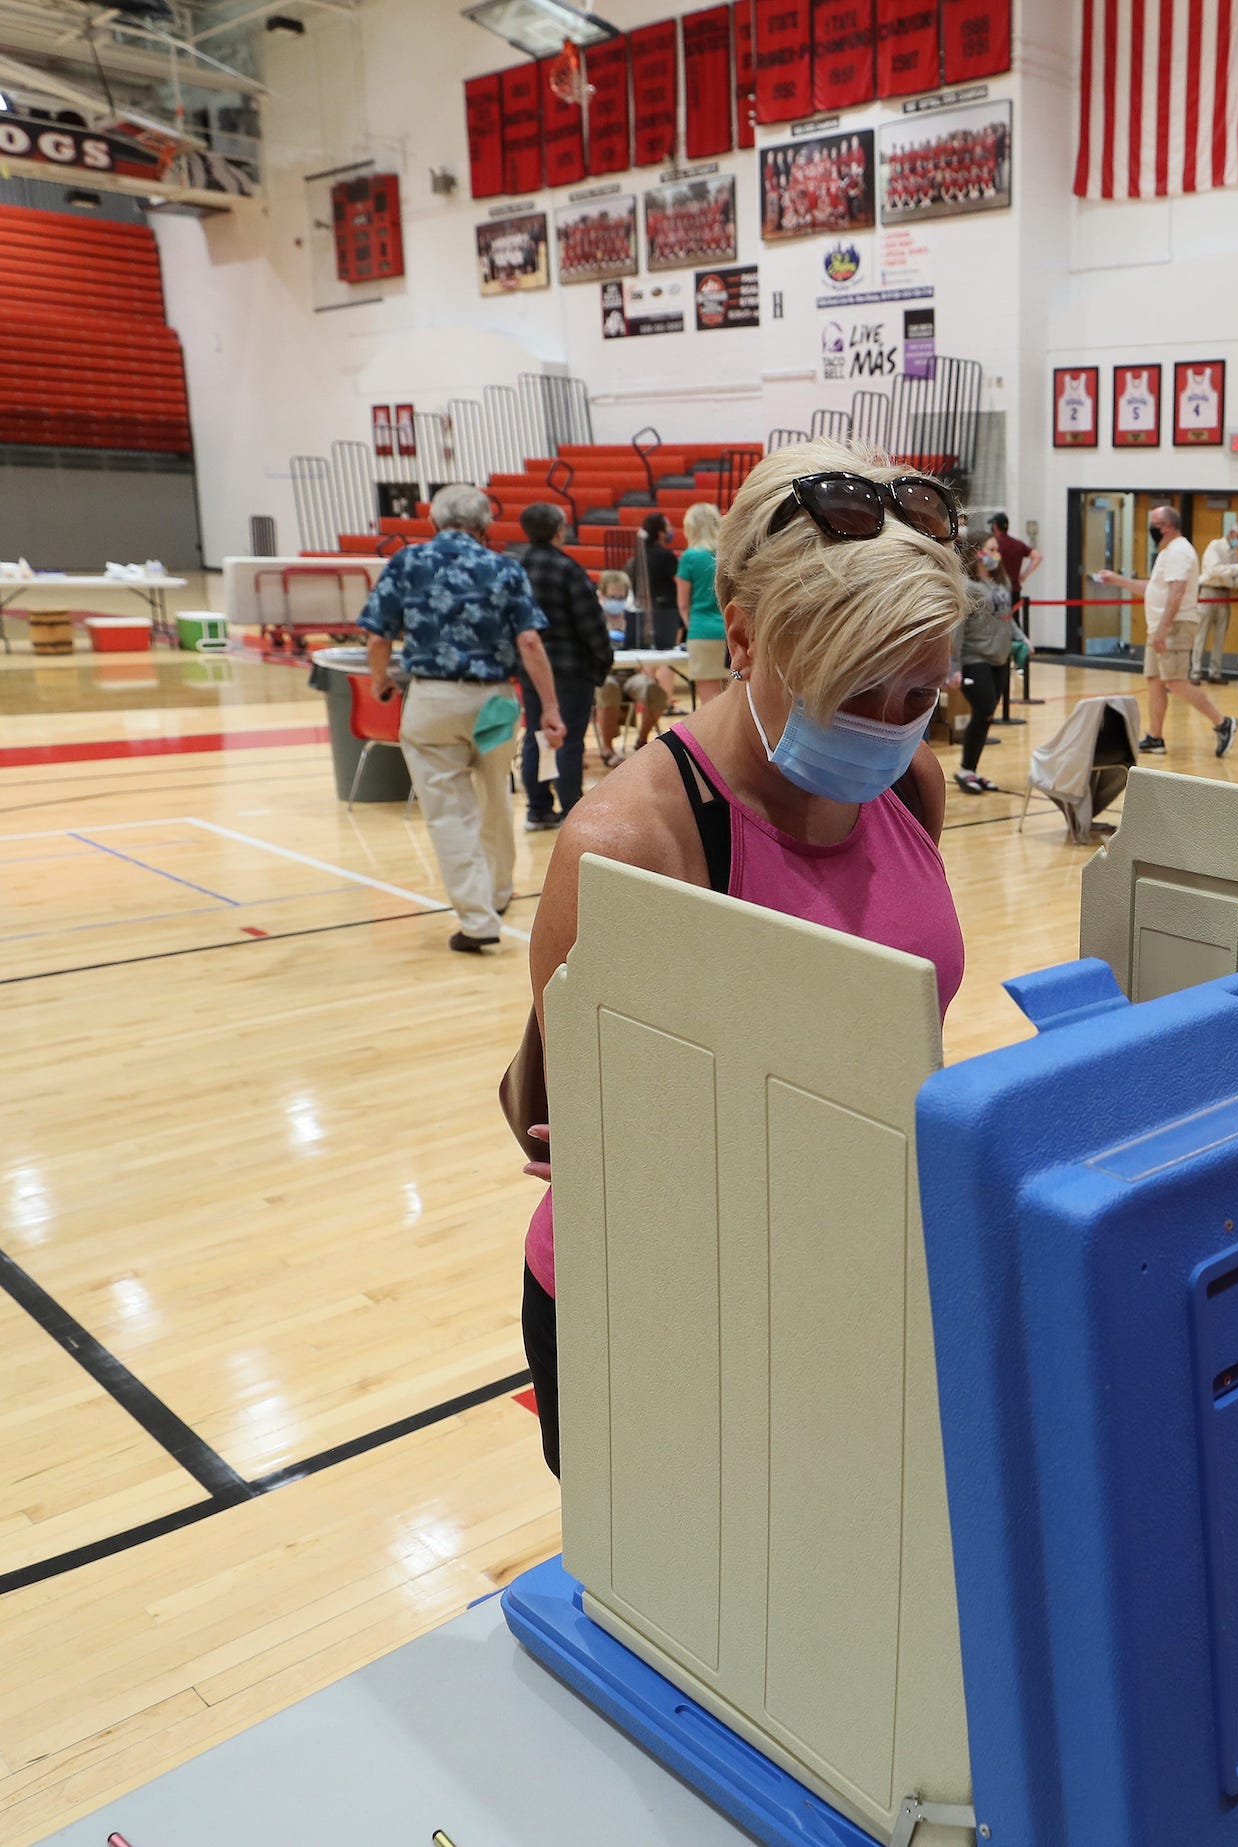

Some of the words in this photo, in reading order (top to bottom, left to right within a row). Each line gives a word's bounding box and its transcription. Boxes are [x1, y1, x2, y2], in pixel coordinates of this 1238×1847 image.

[0, 123, 112, 169] OGS
[849, 323, 883, 347] LIVE
[823, 356, 845, 367] TACO
[824, 369, 844, 379] BELL
[1070, 407, 1078, 420] 2
[1132, 406, 1140, 420] 5
